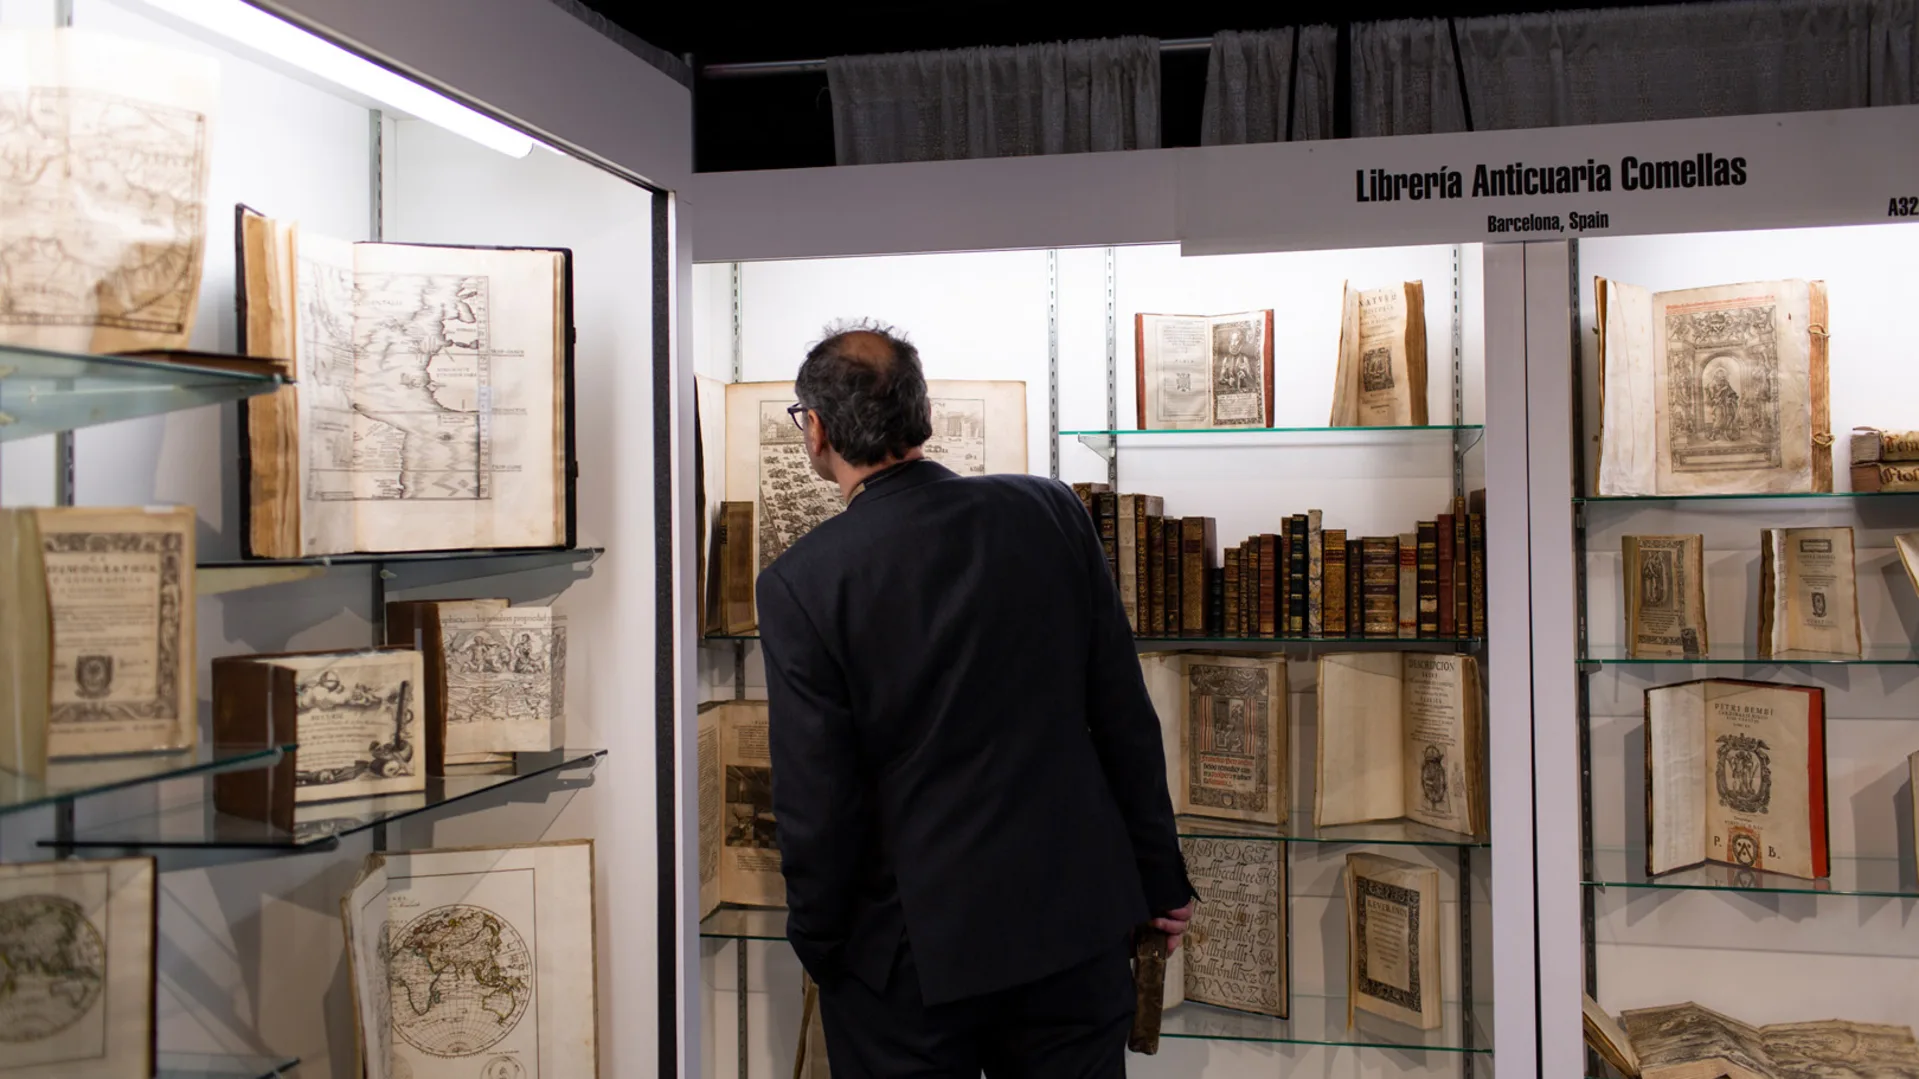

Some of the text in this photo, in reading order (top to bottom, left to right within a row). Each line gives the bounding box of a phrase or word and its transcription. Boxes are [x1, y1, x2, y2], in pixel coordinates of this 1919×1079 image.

[1356, 153, 1746, 202] Librería Anticuaria Comellas
[1487, 211, 1609, 234] Barcelona, Spain
